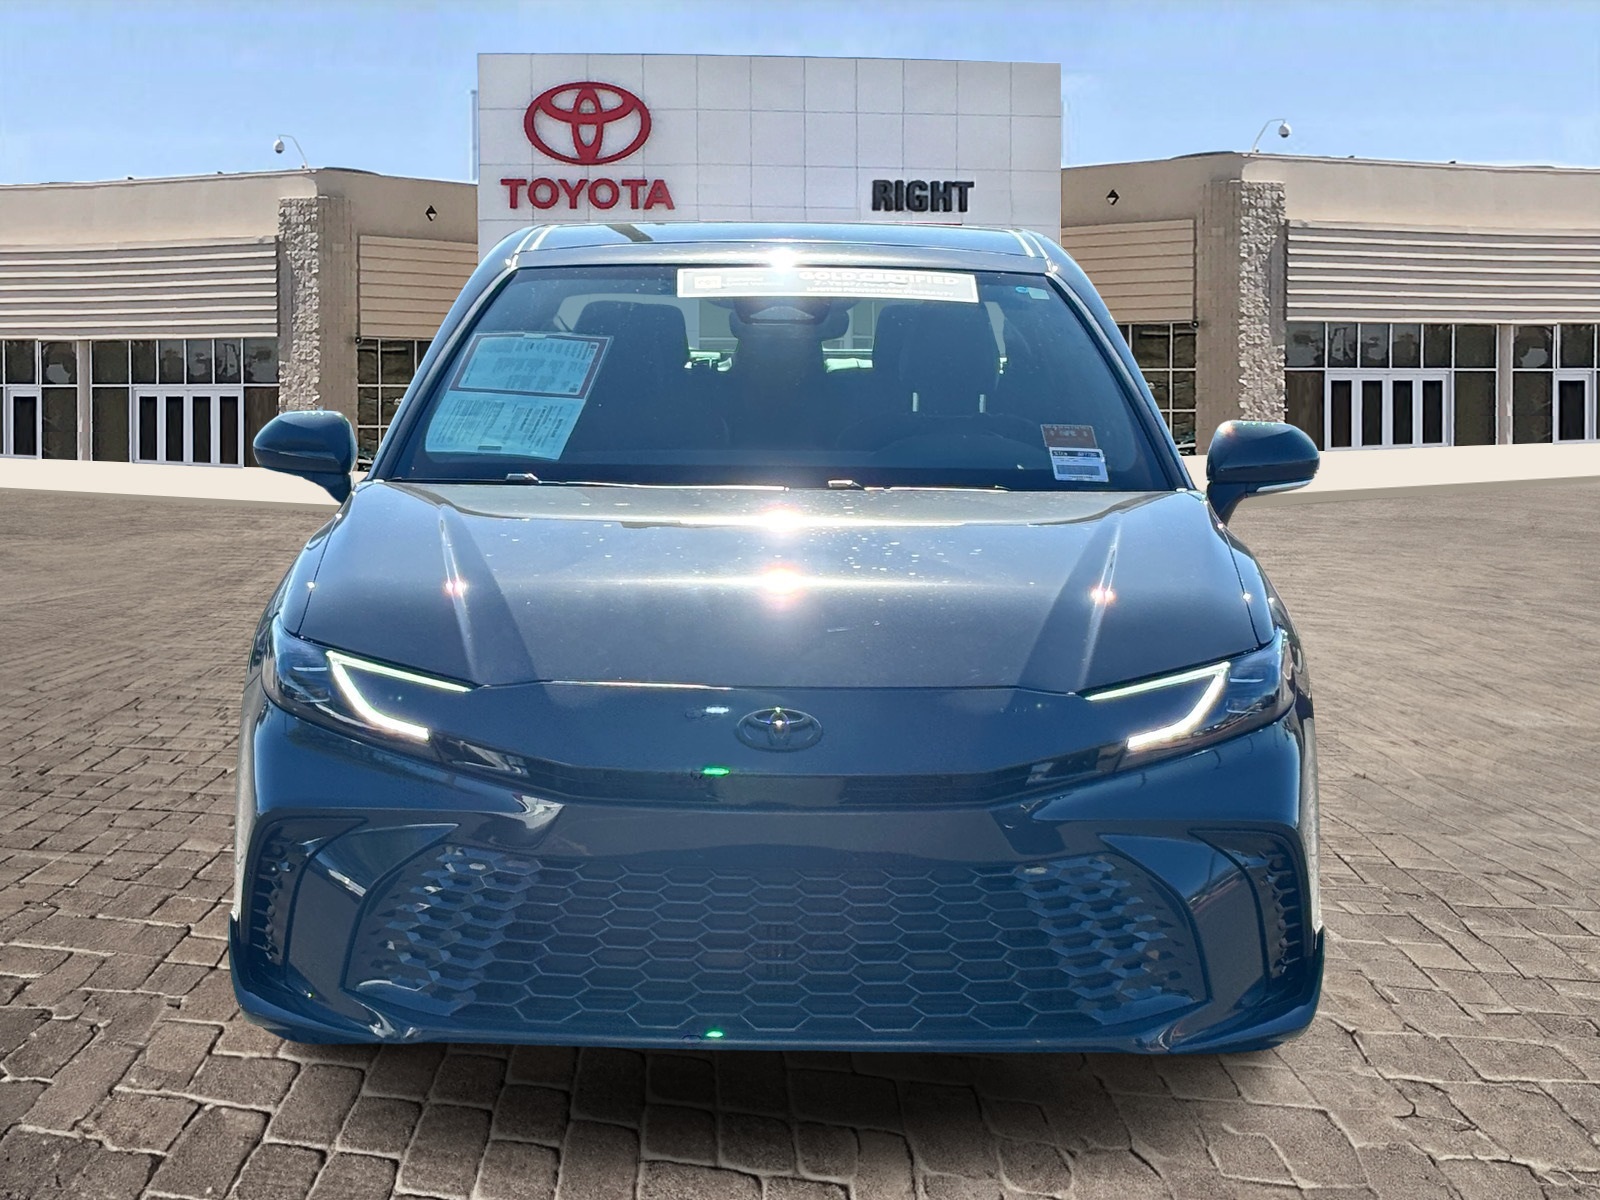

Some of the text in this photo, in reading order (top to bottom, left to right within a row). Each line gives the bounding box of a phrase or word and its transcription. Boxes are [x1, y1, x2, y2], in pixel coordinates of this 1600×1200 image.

[500, 178, 676, 210] TOYOTA
[871, 179, 976, 213] RIGHT
[799, 271, 856, 281] GOLD
